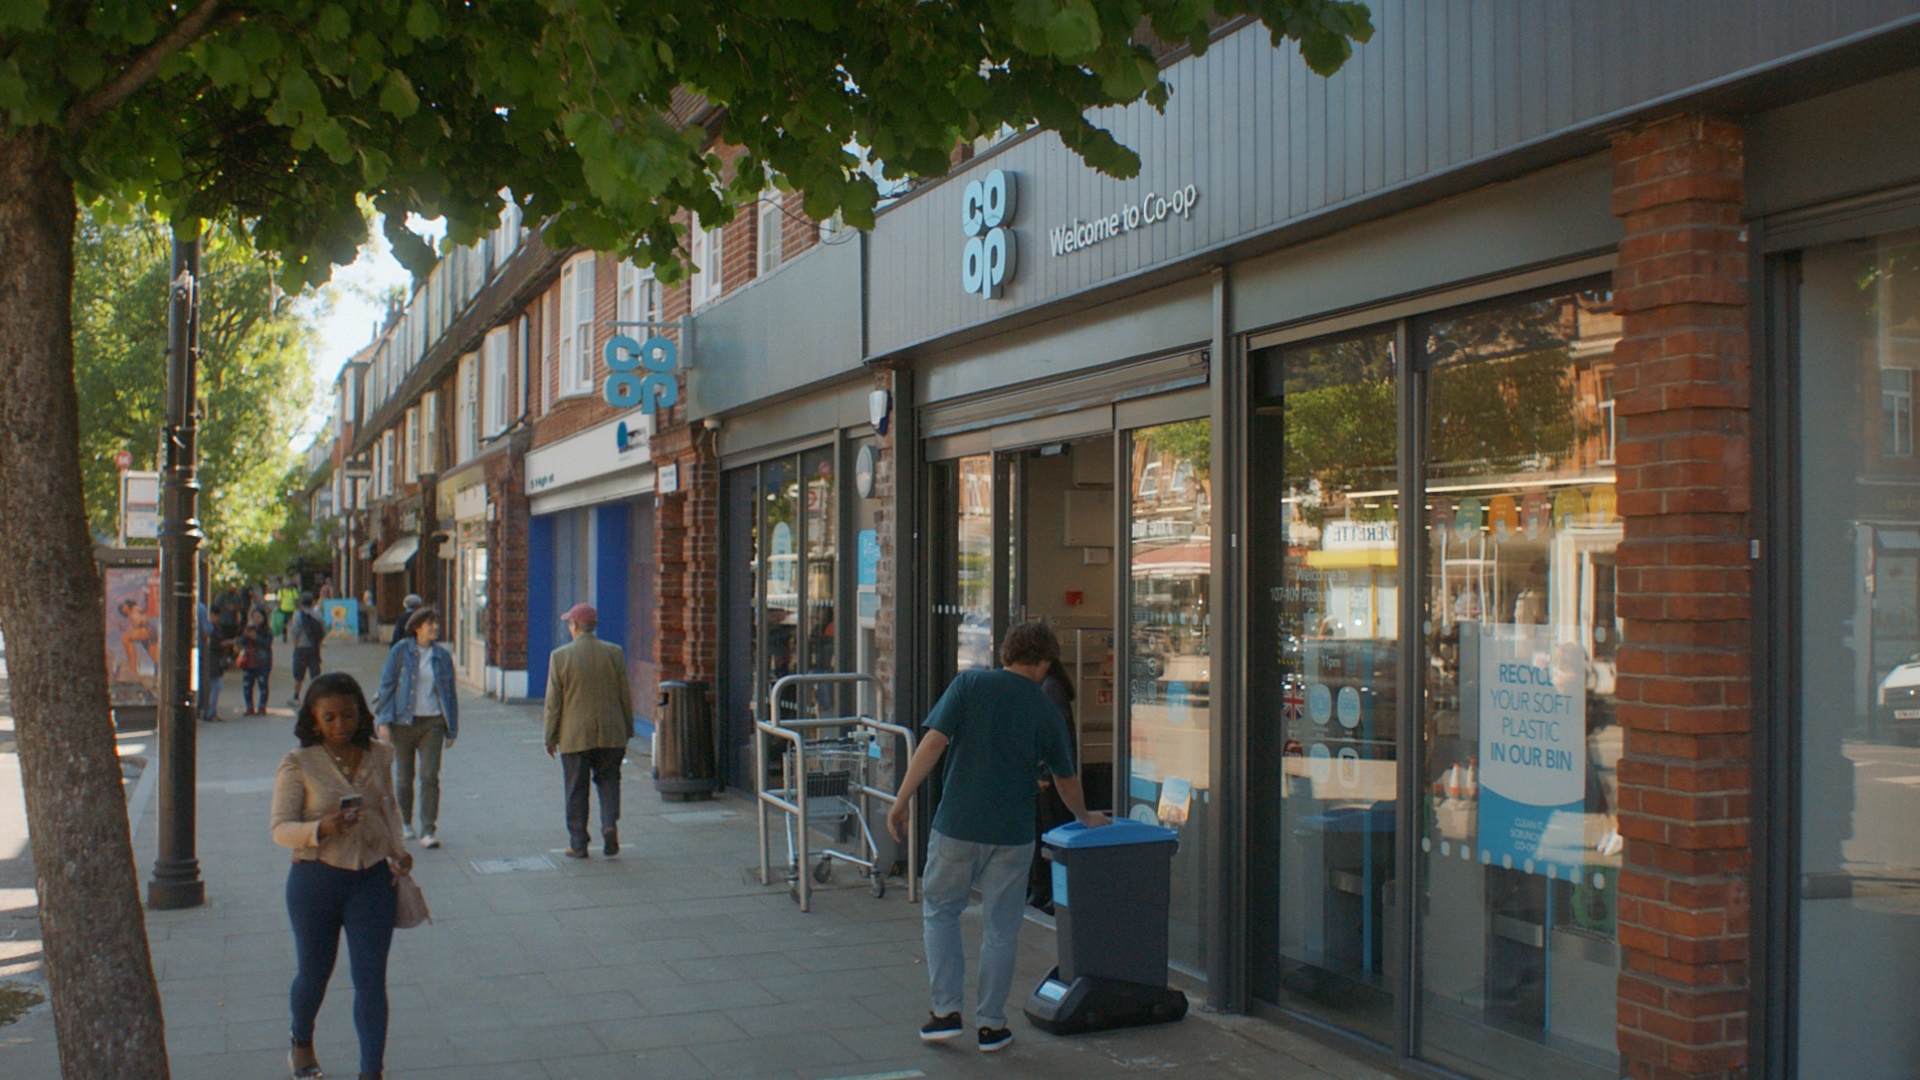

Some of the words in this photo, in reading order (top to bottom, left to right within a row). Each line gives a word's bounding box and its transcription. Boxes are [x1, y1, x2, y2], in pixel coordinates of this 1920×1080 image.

[1050, 214, 1119, 258] Welcome
[1122, 203, 1140, 229] to
[1143, 183, 1198, 225] Co-op
[1296, 567, 1337, 582] Welcome
[1338, 569, 1348, 582] to
[1499, 663, 1553, 686] RECYCL
[1490, 690, 1530, 712] YOUR
[1533, 692, 1573, 716] SOFT
[1502, 717, 1560, 742] PLASTIC
[1490, 742, 1506, 763] IN
[1508, 744, 1543, 767] OUR
[1546, 748, 1573, 771] BIN
